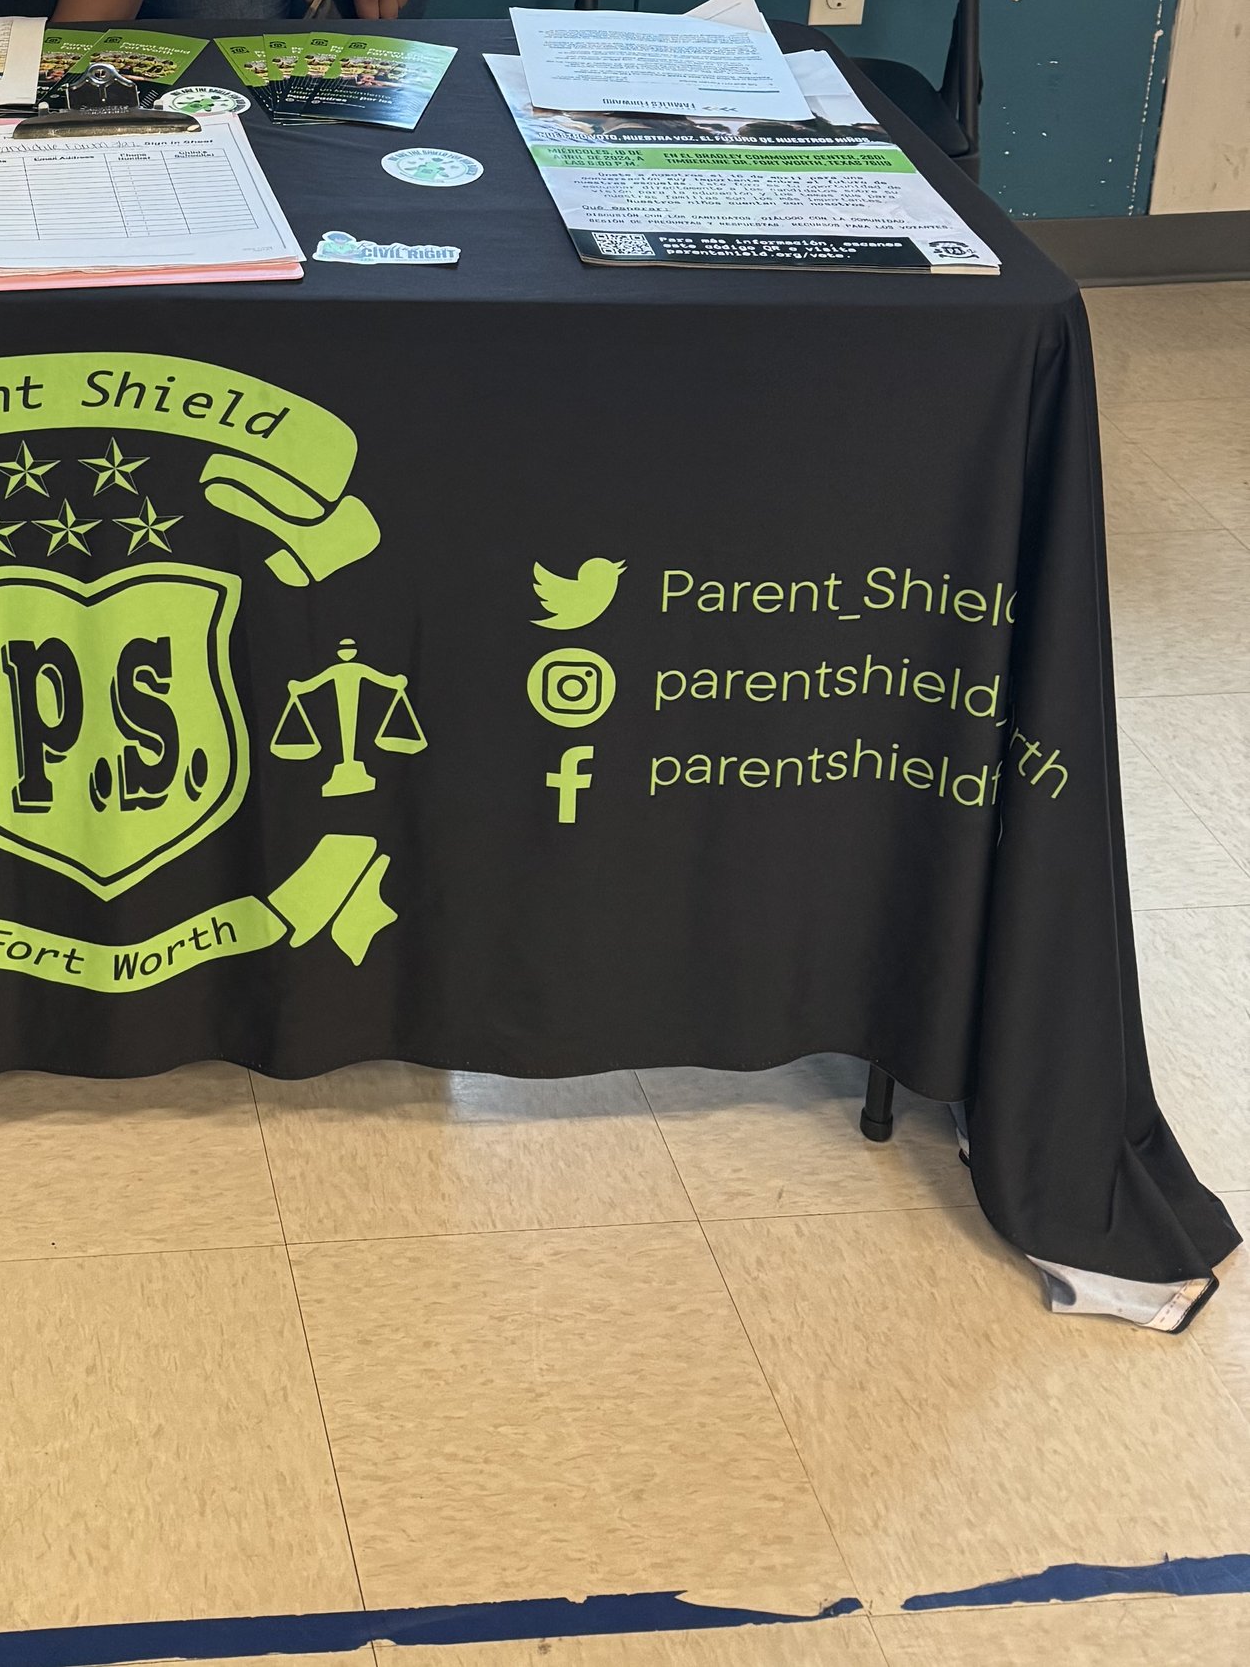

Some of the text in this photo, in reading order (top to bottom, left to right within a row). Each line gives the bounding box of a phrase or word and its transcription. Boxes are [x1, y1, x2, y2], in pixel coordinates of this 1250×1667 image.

[143, 47, 173, 55] Worth
[158, 47, 190, 55] Shield
[361, 247, 455, 258] CIVIL RIGHT
[80, 369, 291, 440] Shield
[111, 916, 237, 982] Worth
